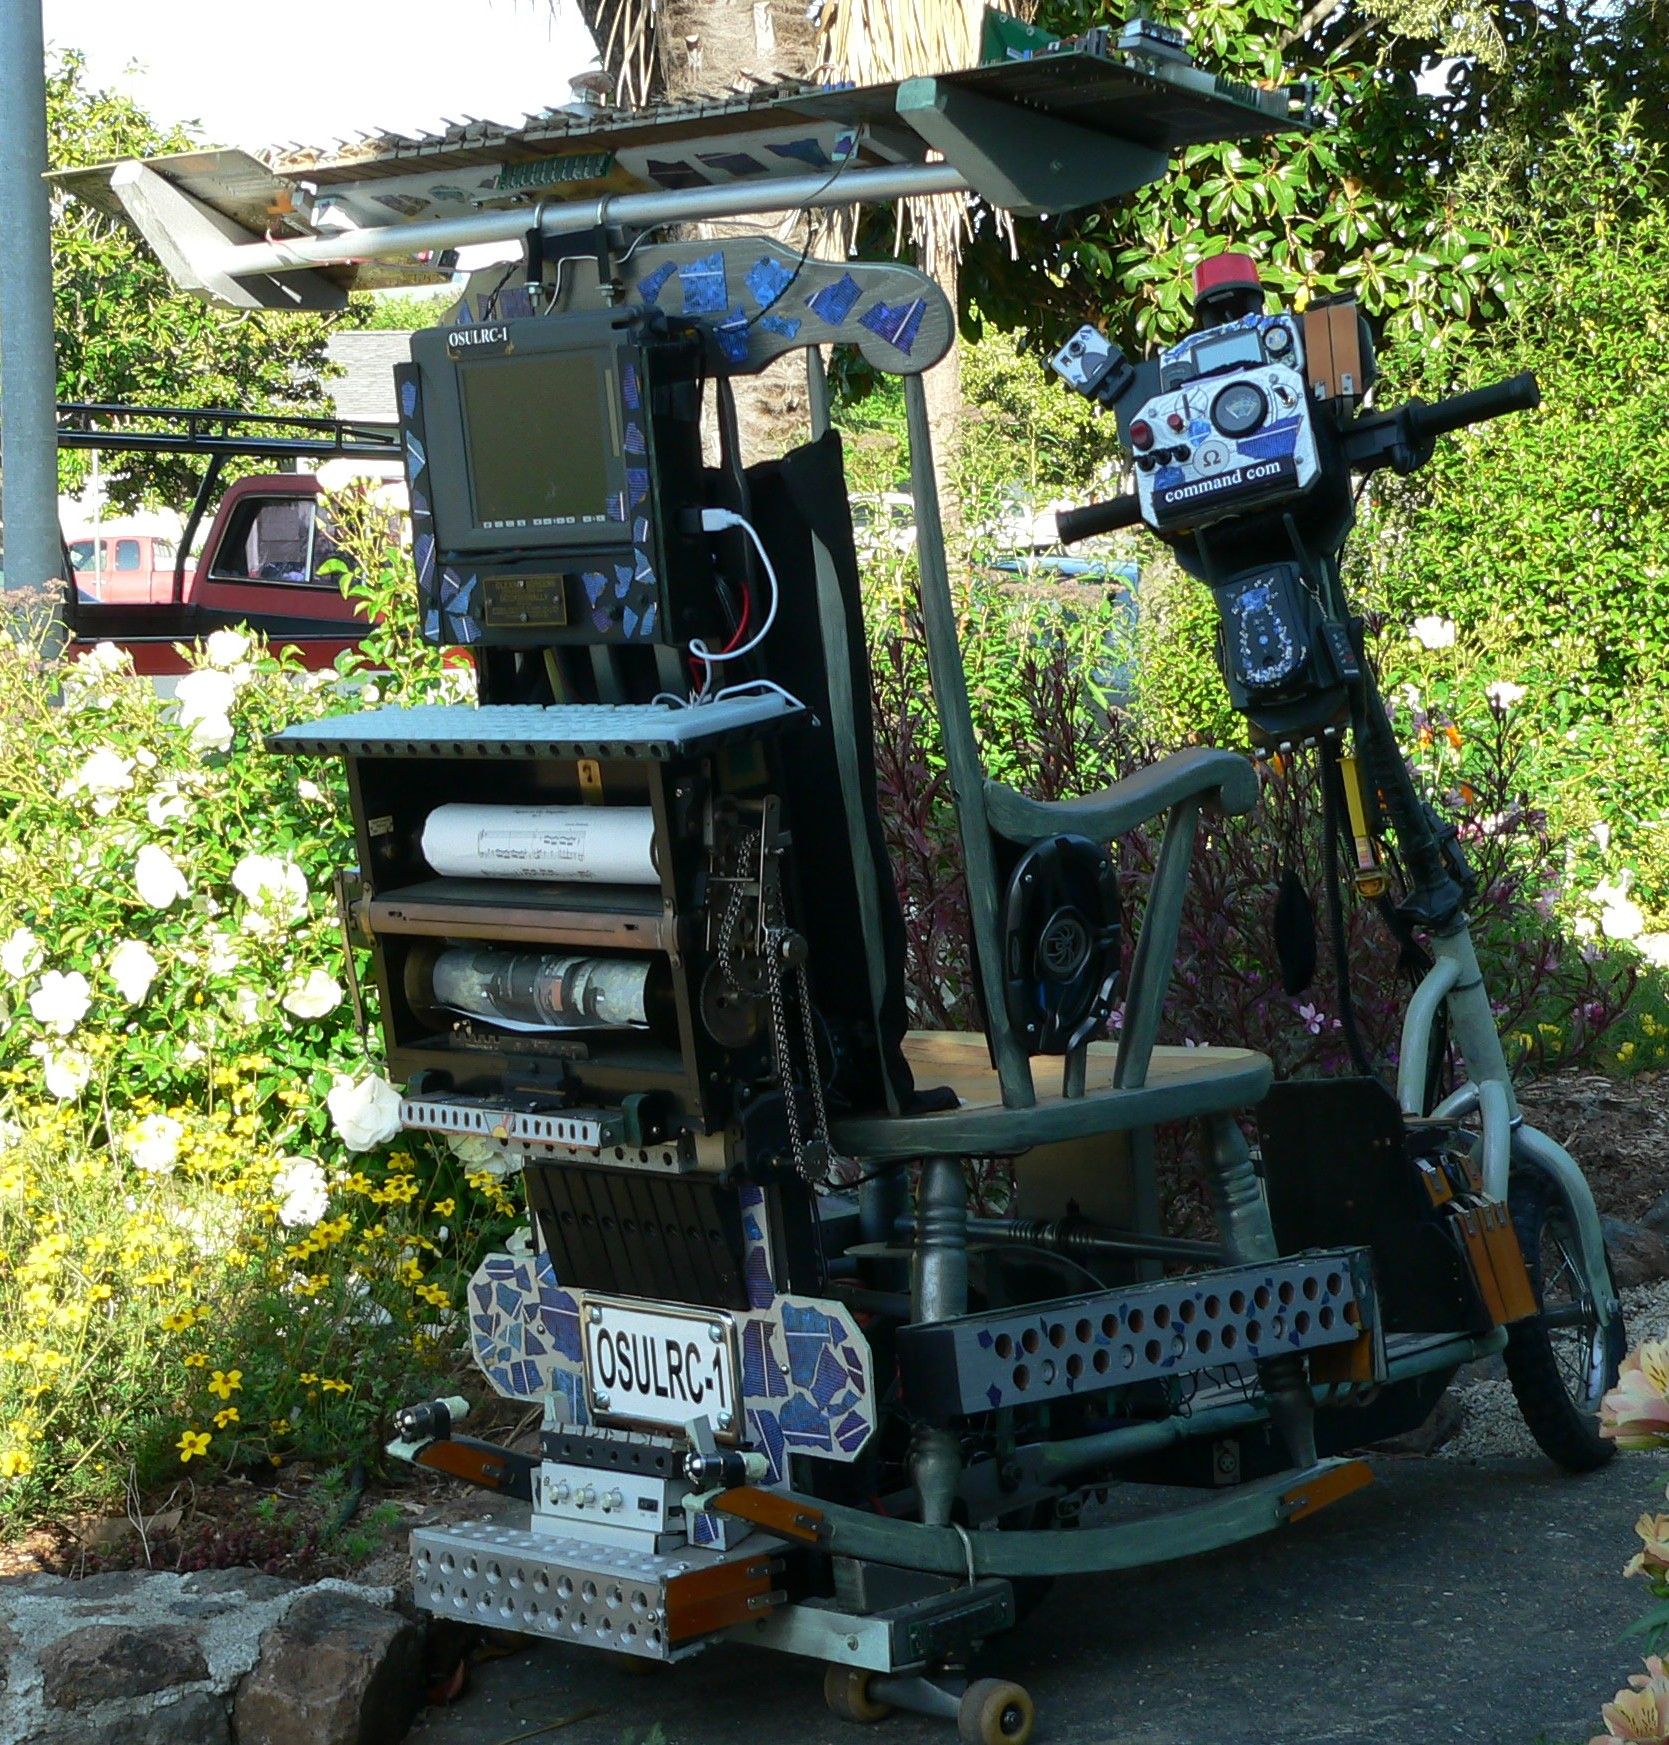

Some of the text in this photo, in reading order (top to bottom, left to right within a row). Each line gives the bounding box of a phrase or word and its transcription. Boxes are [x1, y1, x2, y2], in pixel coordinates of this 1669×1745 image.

[448, 326, 508, 347] OSULRC-1
[1164, 461, 1281, 503] command com
[597, 1327, 726, 1409] OSULRC-1
